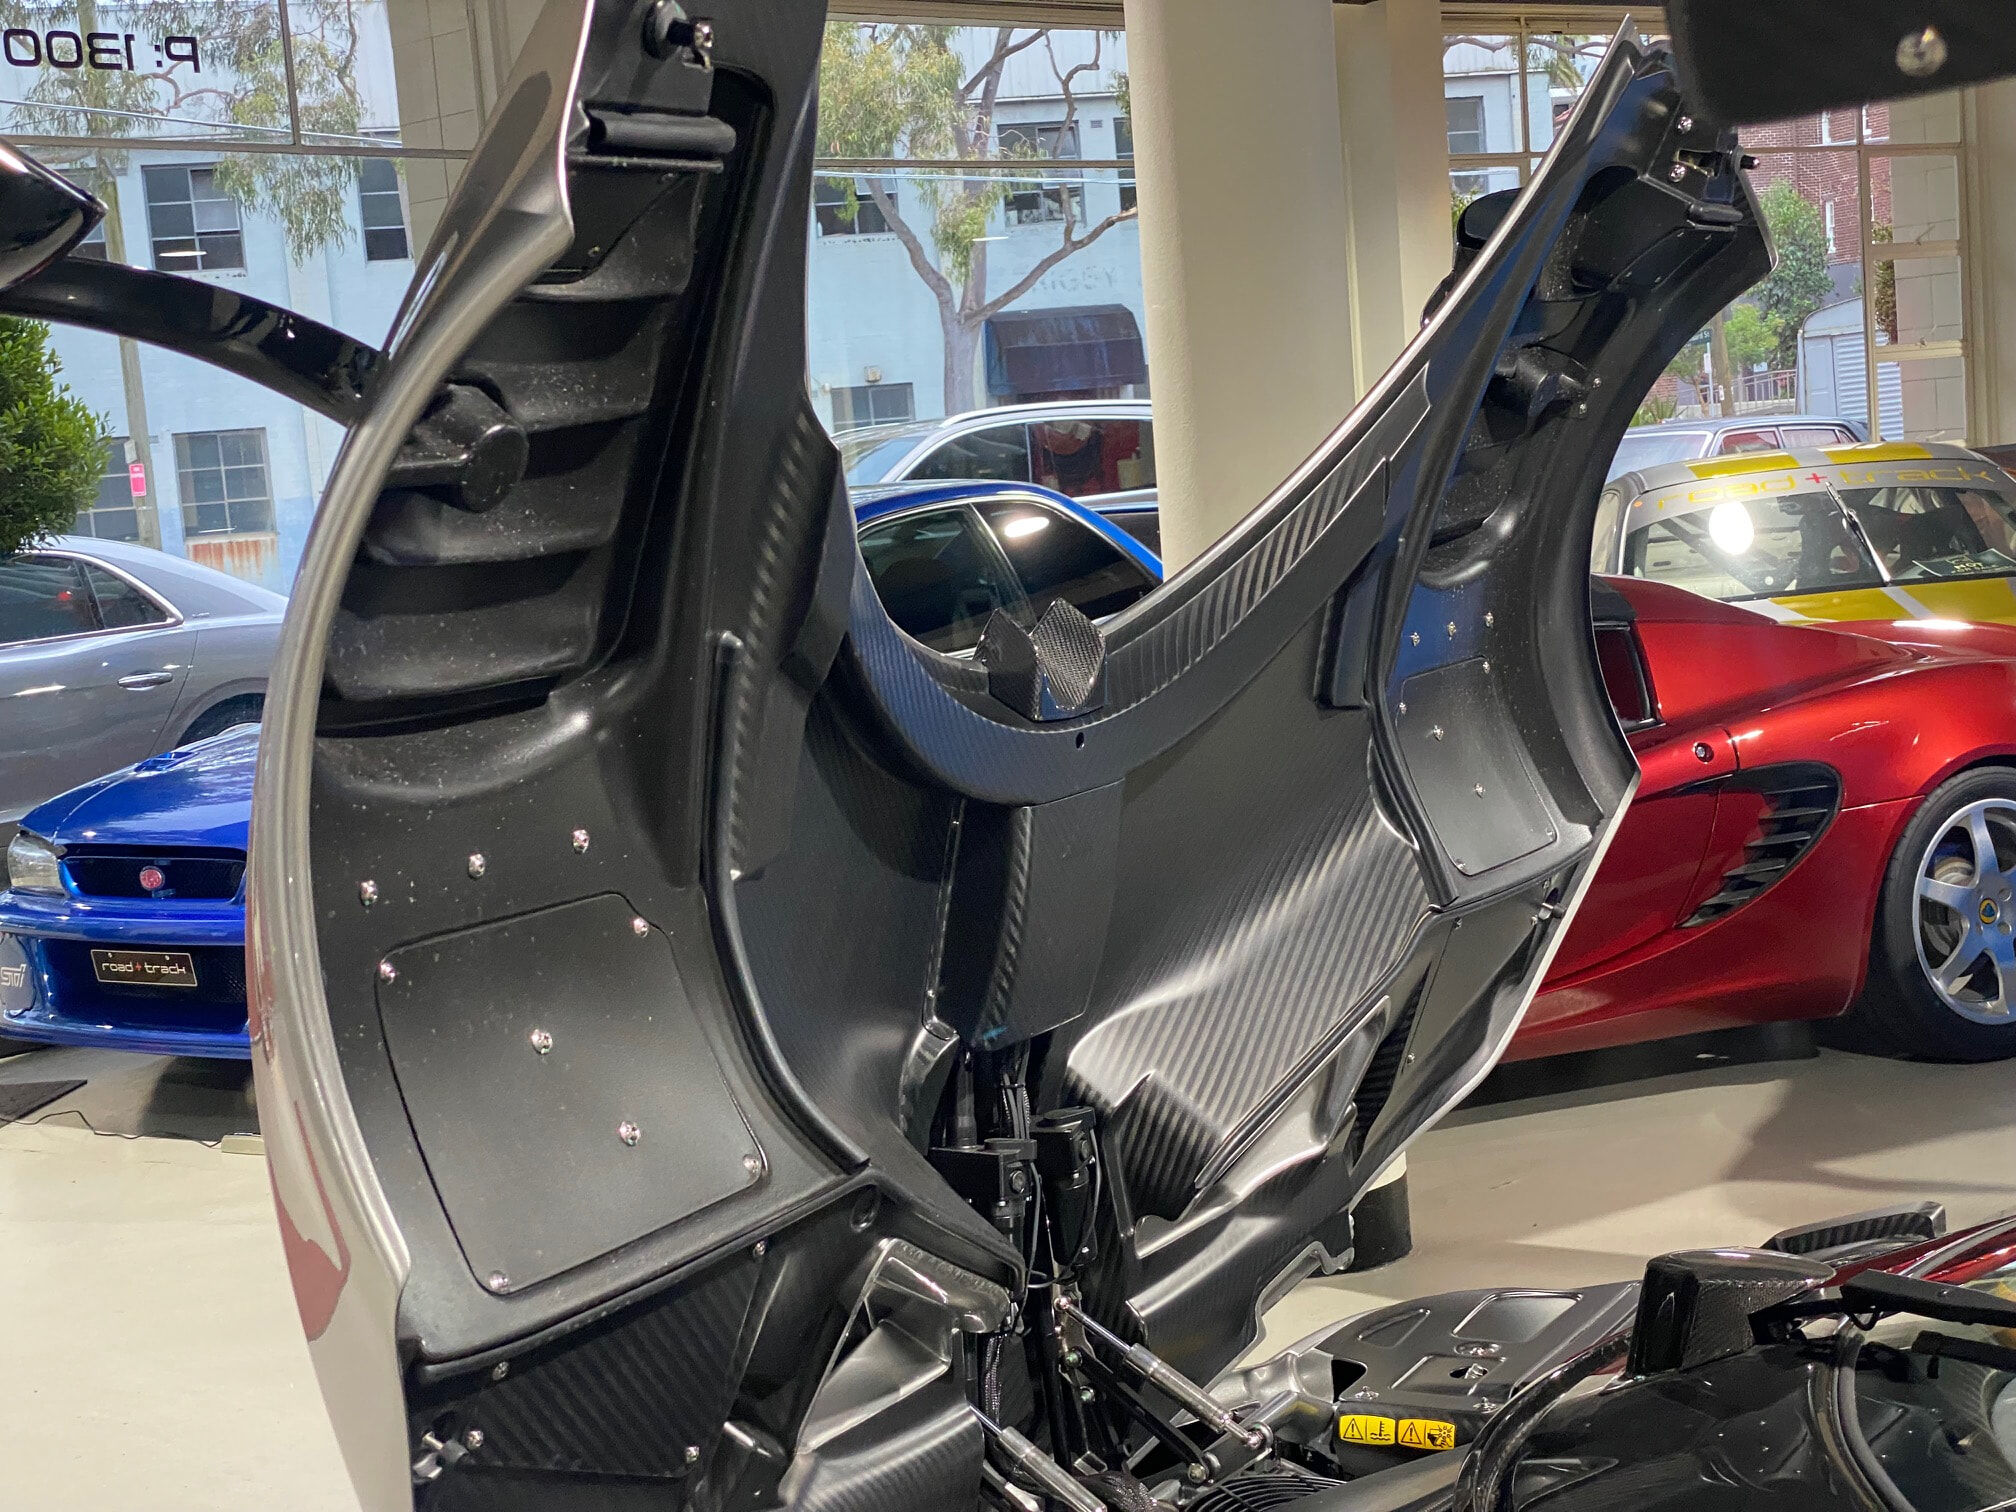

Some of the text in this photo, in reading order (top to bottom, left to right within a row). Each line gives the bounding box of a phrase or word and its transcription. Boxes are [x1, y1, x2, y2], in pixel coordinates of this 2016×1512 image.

[1658, 474, 1796, 511] road
[1839, 466, 1996, 485] track
[102, 961, 134, 973] road
[144, 962, 187, 975] track
